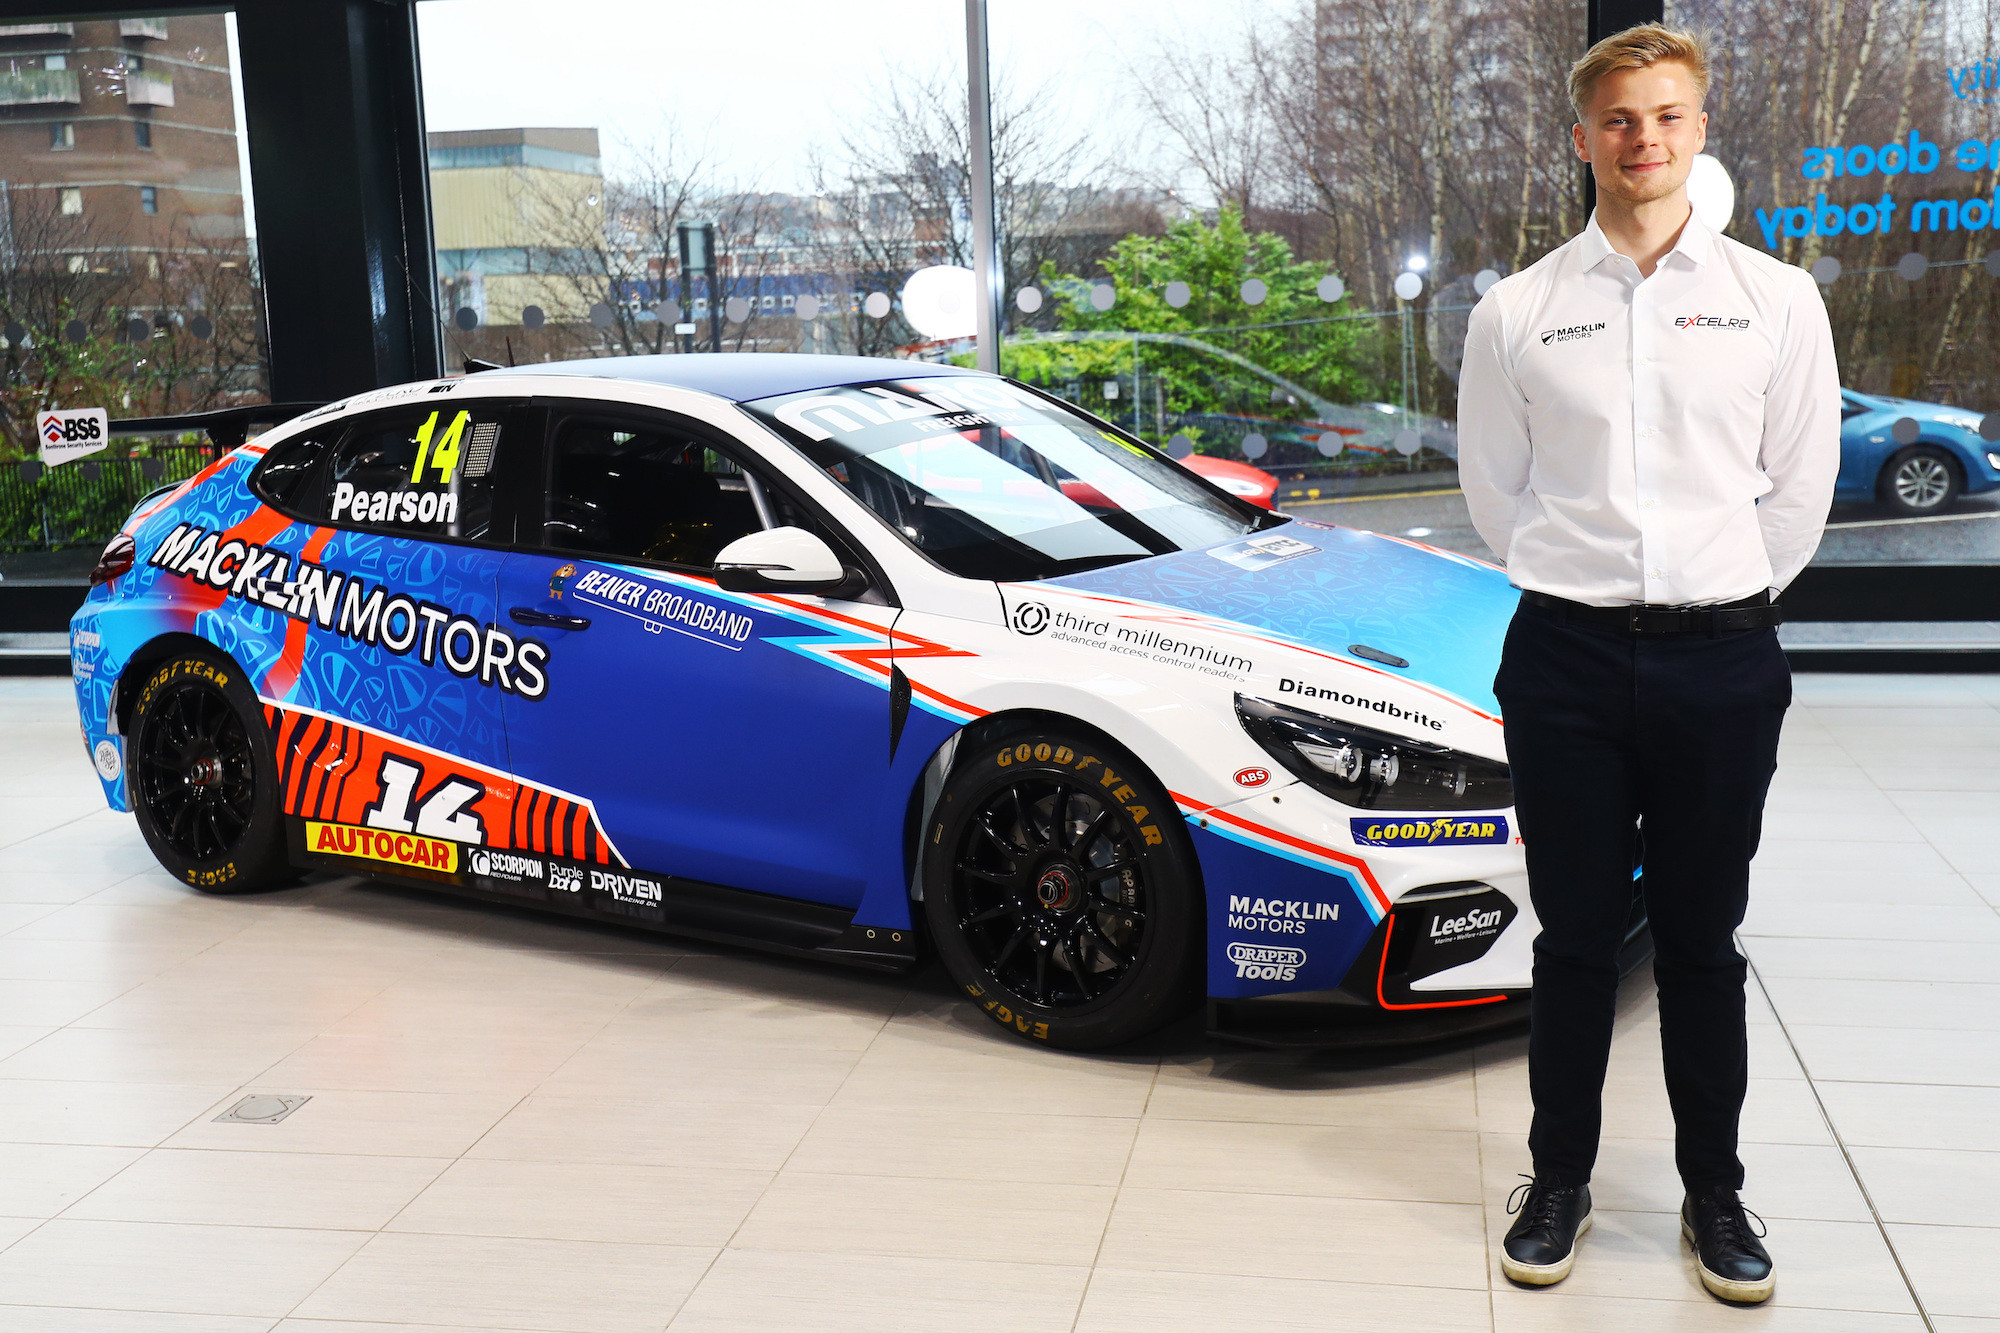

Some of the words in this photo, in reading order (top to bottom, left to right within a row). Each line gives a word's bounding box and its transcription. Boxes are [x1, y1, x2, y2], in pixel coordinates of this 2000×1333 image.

[1557, 322, 1605, 337] MACKLIN
[1674, 314, 1750, 330] EXCELR8
[1557, 331, 1592, 342] MOTORS
[911, 412, 998, 433] FREIGHT
[411, 410, 469, 484] 14
[331, 482, 459, 523] Pearson
[150, 526, 343, 626] MACKLIN
[338, 581, 549, 699] MOTORS
[575, 569, 647, 608] BEAVER
[643, 589, 754, 642] BROADBAND
[1051, 630, 1107, 650] advanced
[1109, 644, 1149, 659] access
[1152, 653, 1196, 670] control
[1055, 611, 1109, 636] third
[1117, 627, 1253, 673] millennium
[1278, 678, 1443, 731] Diamondbrite
[1241, 770, 1265, 784] ABS
[316, 825, 450, 870] AUTOCAR
[491, 853, 543, 879] SCORPION
[549, 862, 584, 881] Purple
[548, 874, 571, 891] Dot
[590, 870, 662, 901] DRIVEN
[619, 896, 645, 906] RACING
[646, 900, 658, 908] OIL
[1229, 894, 1340, 921] MACKLIN
[1228, 913, 1306, 935] MOTORS
[1430, 908, 1502, 938] LeeSan
[1233, 946, 1299, 964] DRAPER
[1234, 959, 1297, 982] Tools
